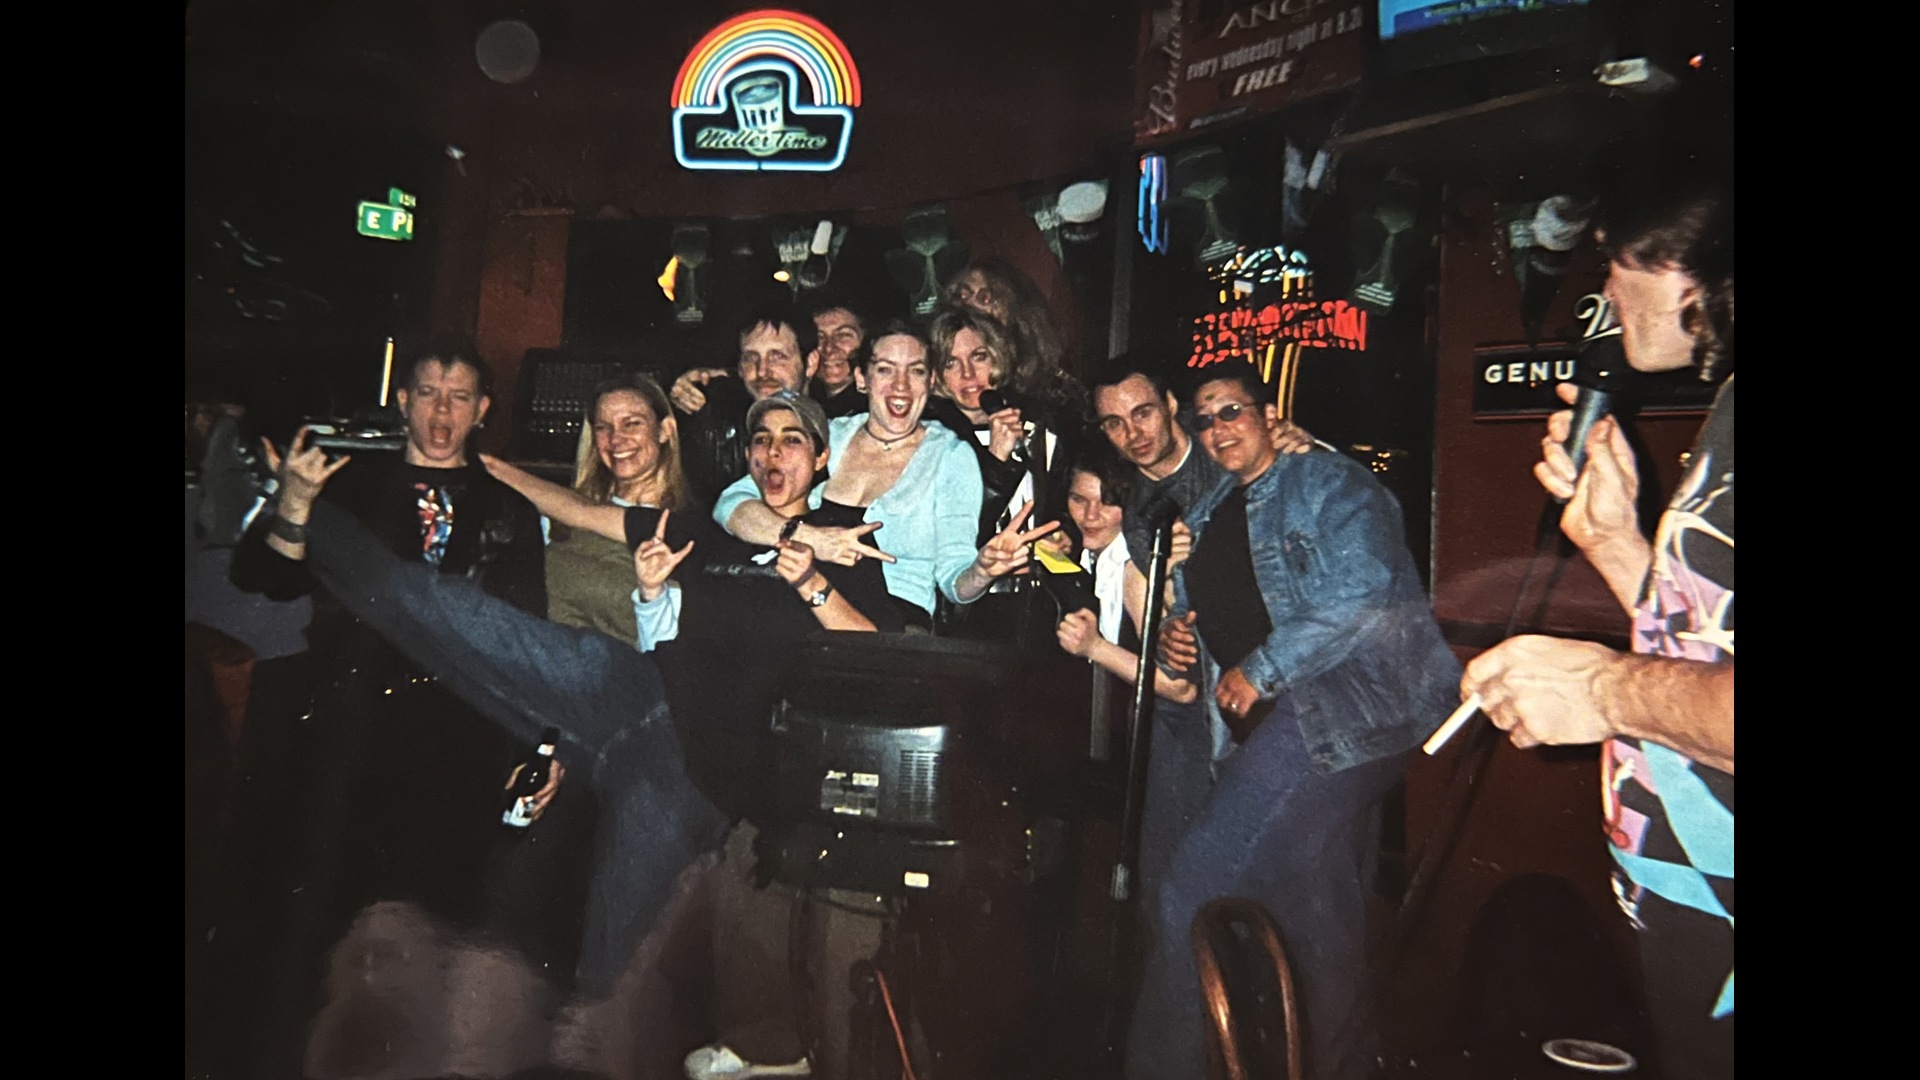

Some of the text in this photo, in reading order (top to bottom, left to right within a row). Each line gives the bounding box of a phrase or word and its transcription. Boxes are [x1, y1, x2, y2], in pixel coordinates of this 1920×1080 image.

[1232, 58, 1294, 97] FREE
[696, 129, 826, 148] Miller Time
[367, 210, 413, 234] E Pi
